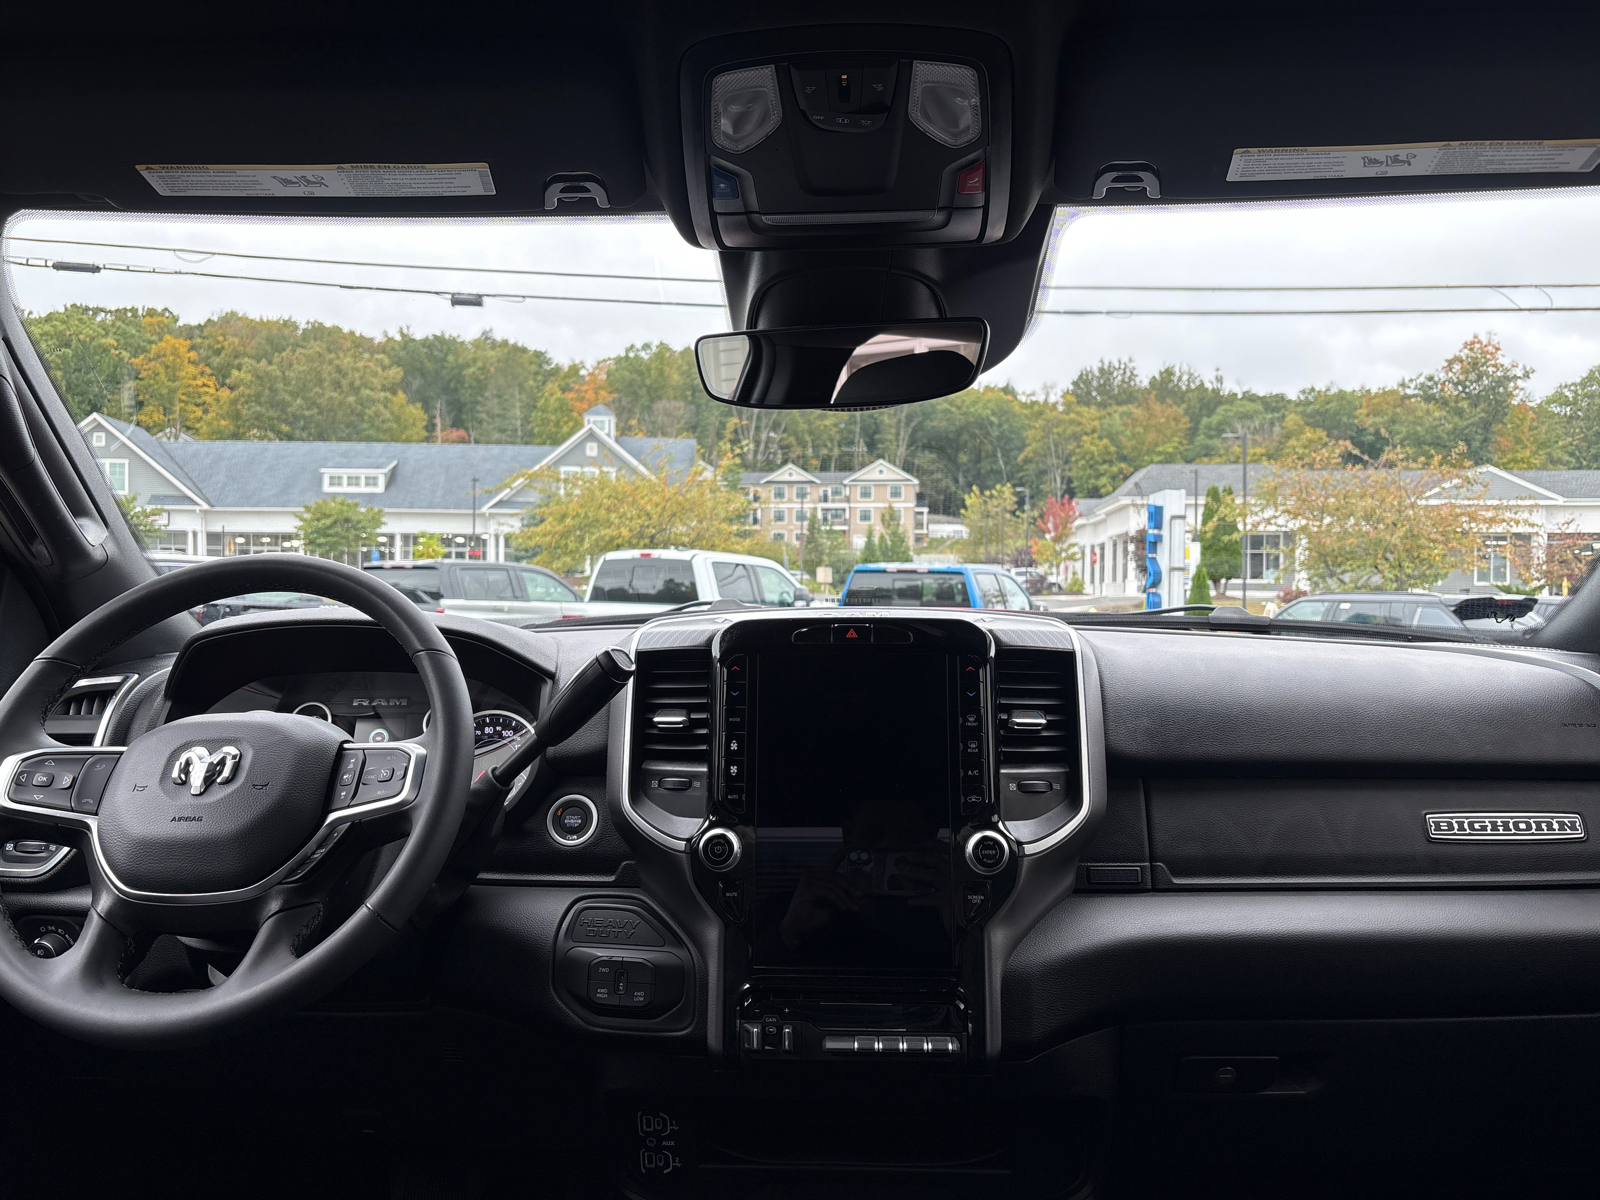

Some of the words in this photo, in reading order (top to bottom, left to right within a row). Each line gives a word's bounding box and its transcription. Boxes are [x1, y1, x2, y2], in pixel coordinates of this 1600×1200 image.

[352, 698, 408, 706] RAM
[484, 726, 494, 734] 80
[1429, 818, 1583, 834] BIGHORN
[579, 917, 641, 930] HEAVY
[585, 927, 636, 939] DUTY
